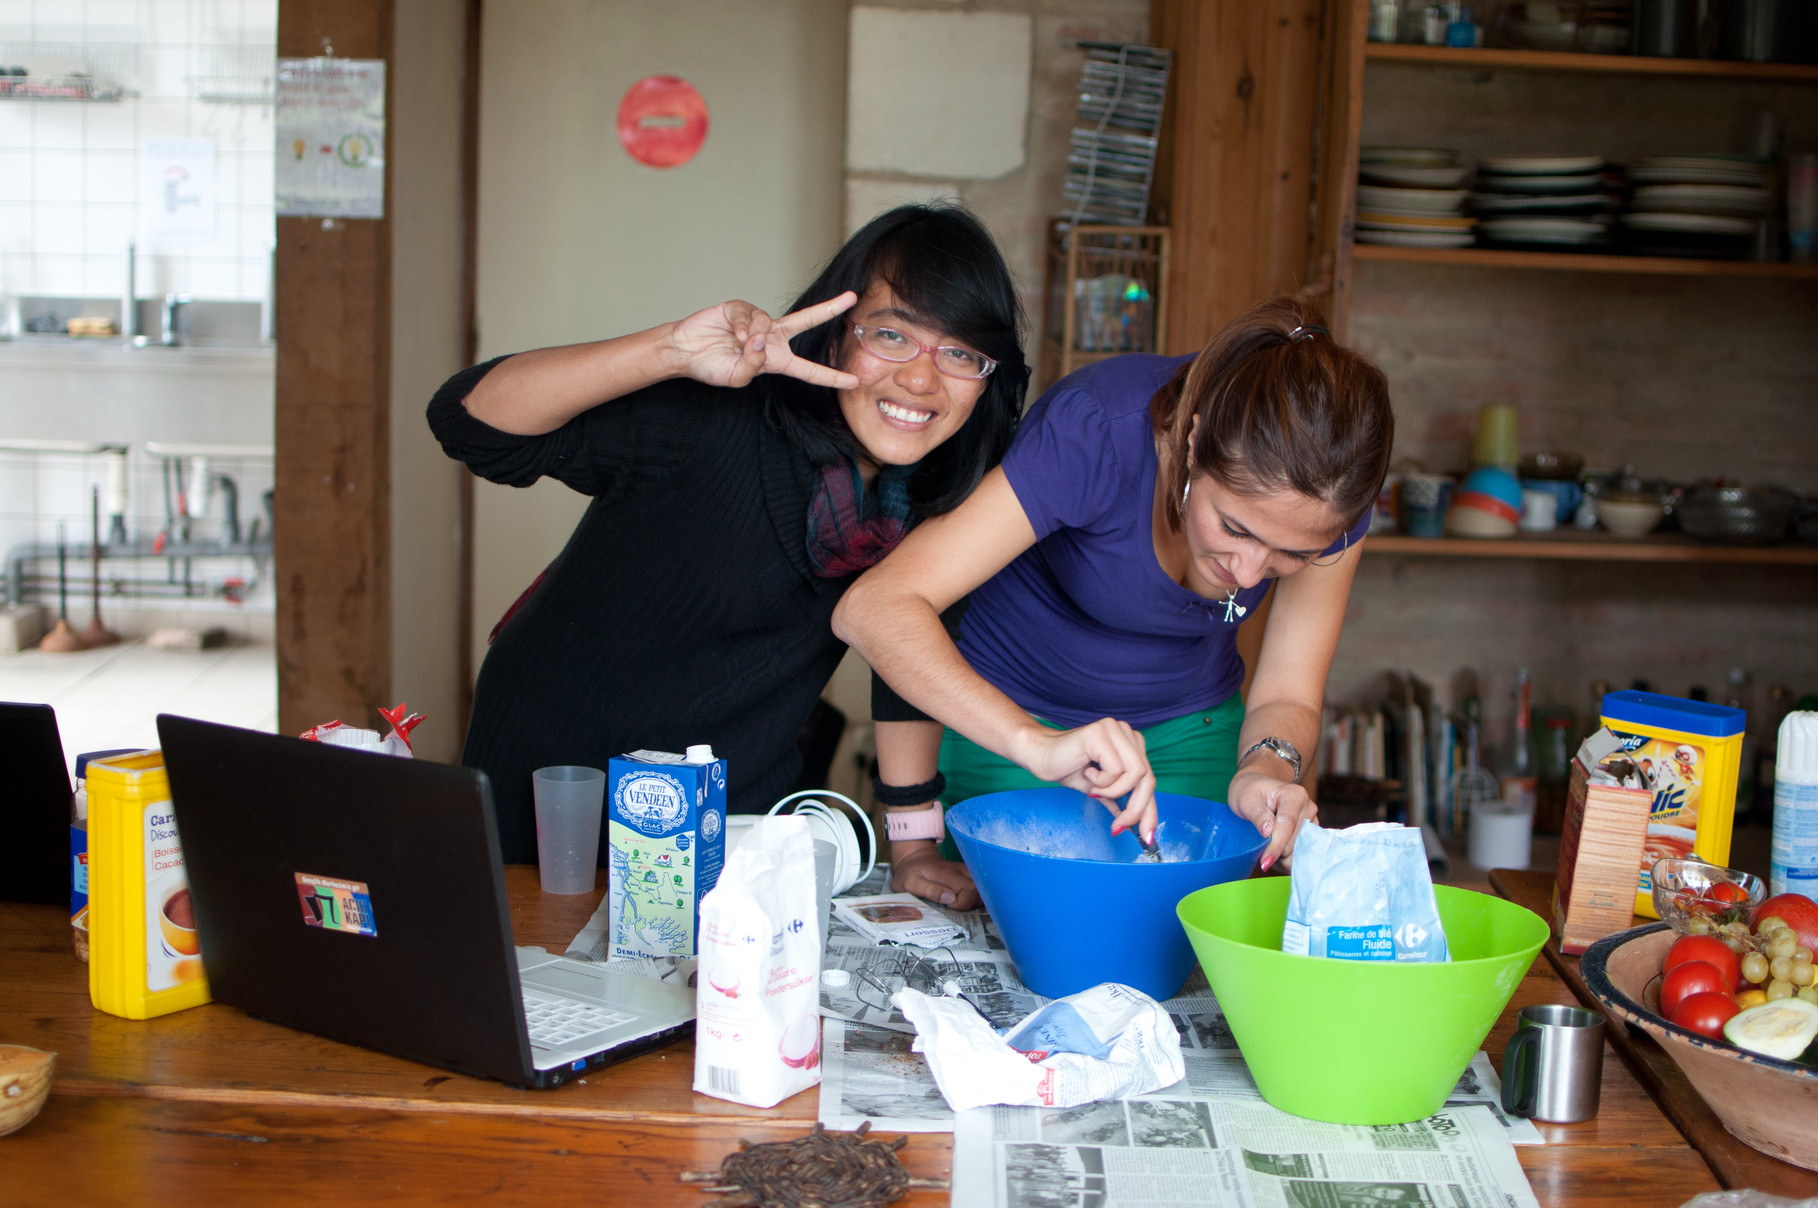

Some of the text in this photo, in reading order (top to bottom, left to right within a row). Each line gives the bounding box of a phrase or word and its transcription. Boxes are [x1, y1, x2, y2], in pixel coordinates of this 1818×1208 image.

[639, 783, 666, 794] LE PETIT
[642, 821, 661, 830] GLAC
[1338, 928, 1392, 939] Farine de blé
[1362, 939, 1392, 950] Fluide
[1397, 951, 1428, 960] Carrefour
